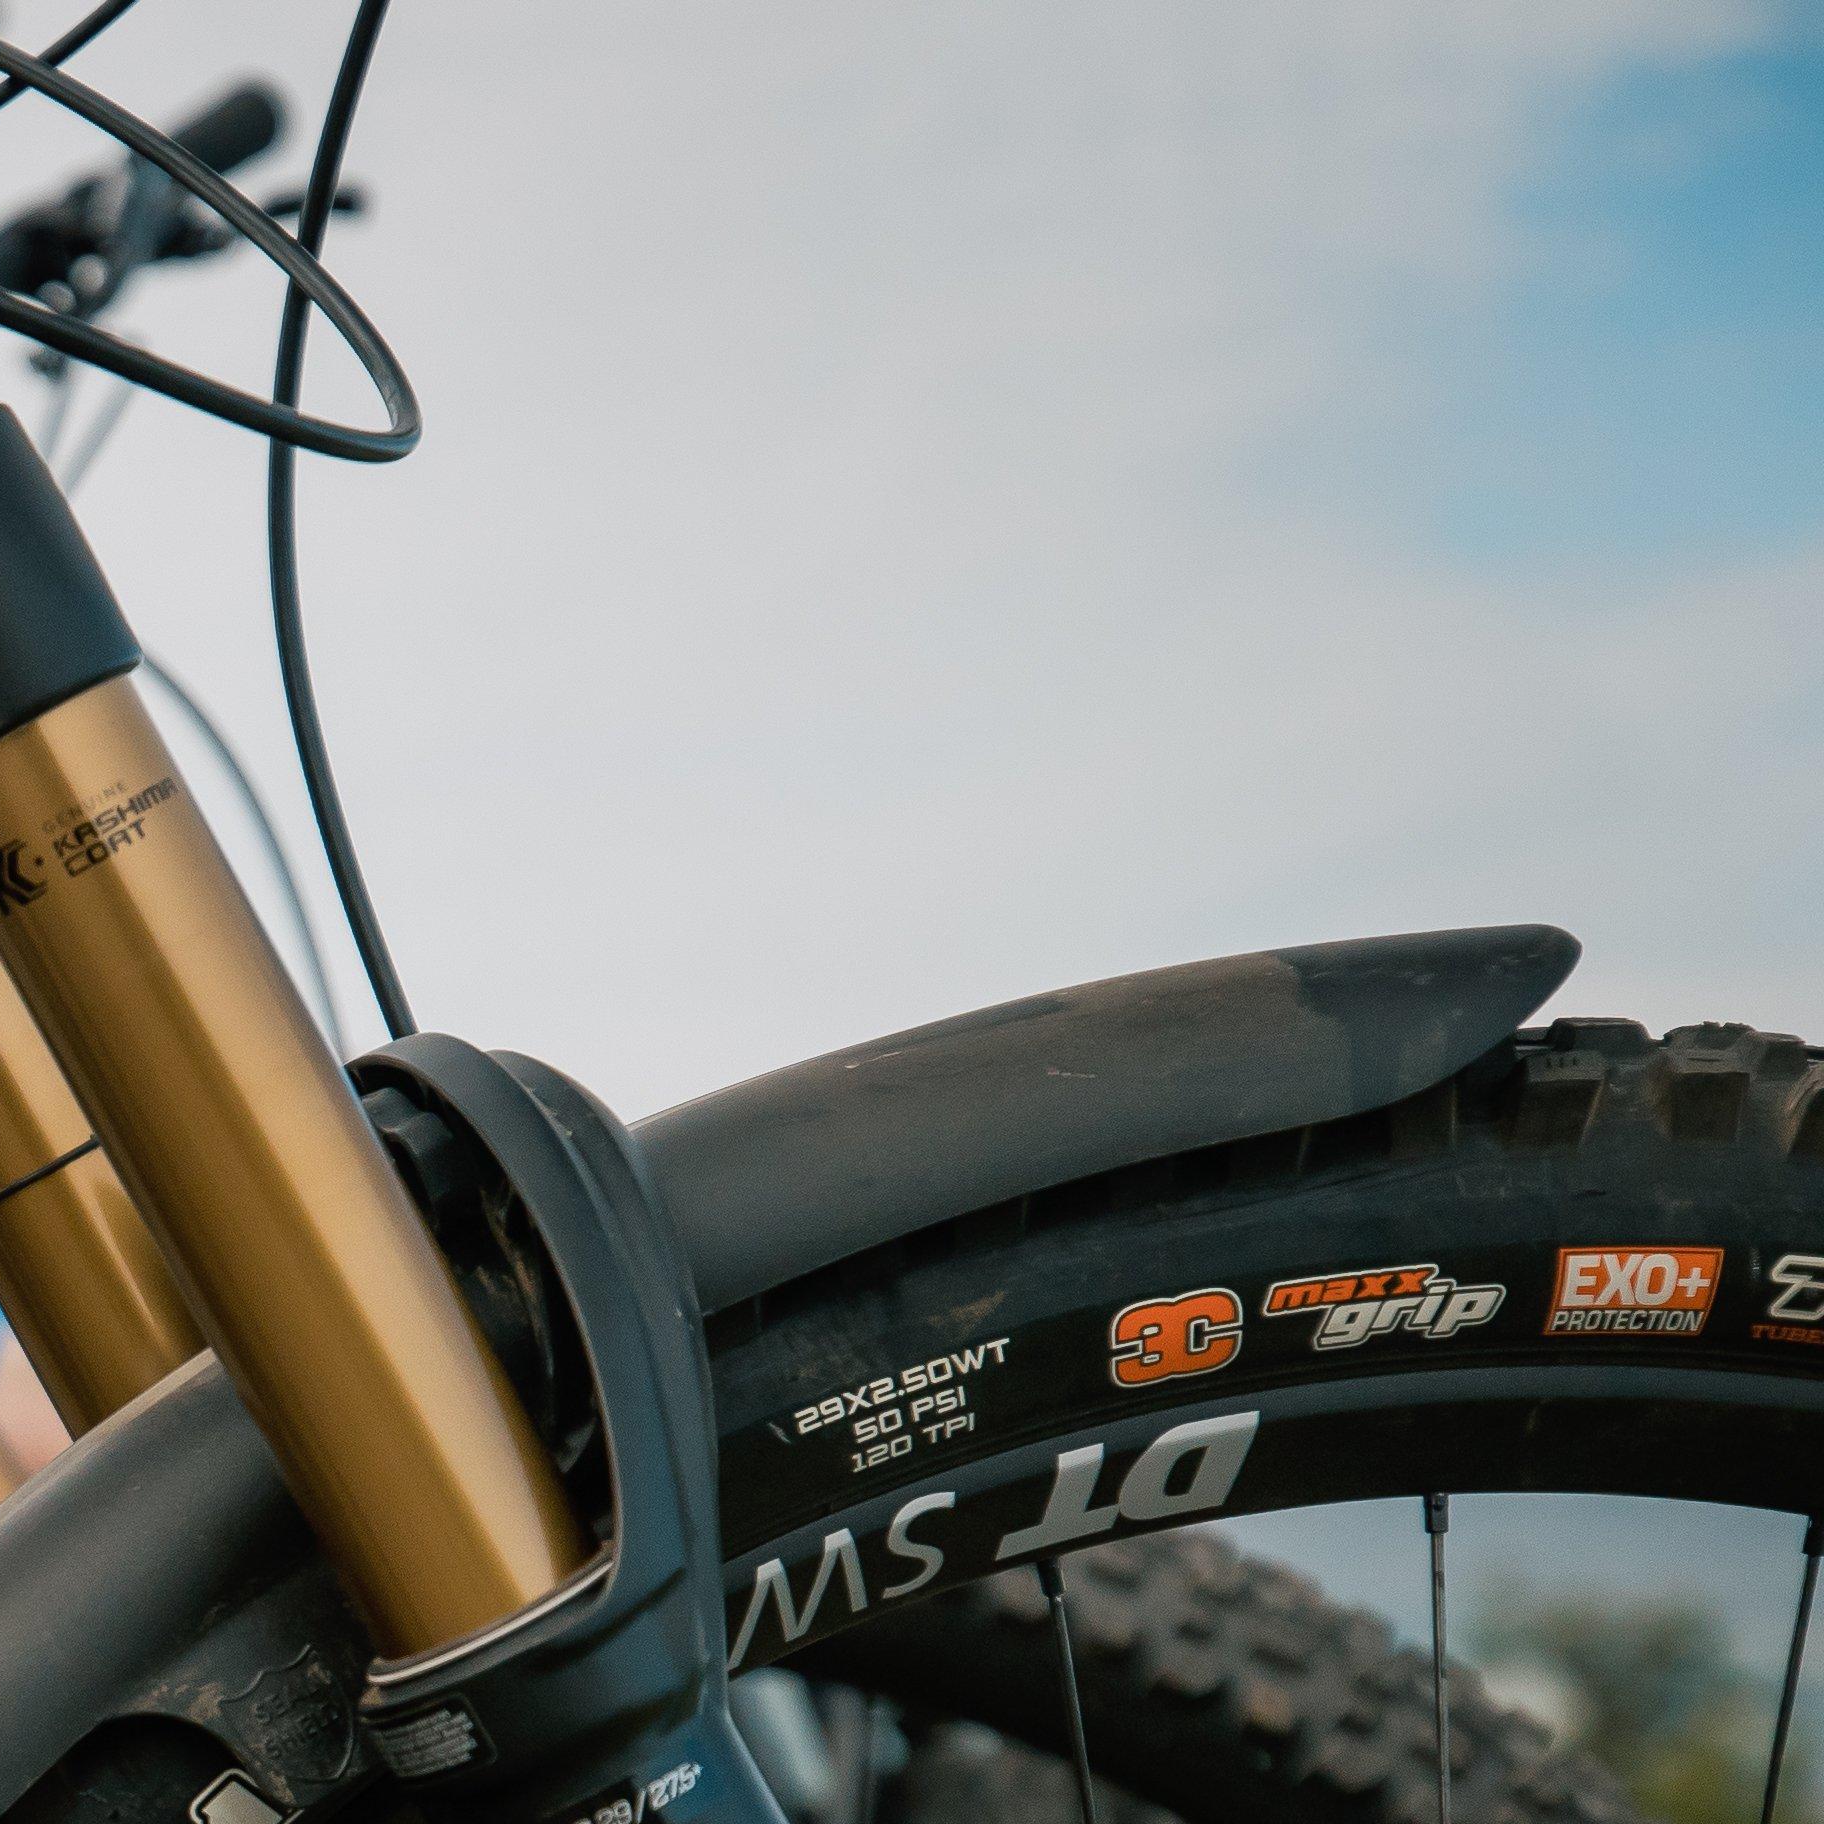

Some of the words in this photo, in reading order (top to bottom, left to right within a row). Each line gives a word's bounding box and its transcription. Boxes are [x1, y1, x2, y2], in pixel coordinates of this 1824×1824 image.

[54, 777, 179, 859] KASHIMA
[63, 817, 147, 878] COAT
[1561, 1253, 1711, 1307] EXO+
[1112, 1287, 1243, 1388] 3C
[1551, 1310, 1704, 1331] PROTECTION
[1752, 1325, 1824, 1345] TUBE
[794, 1337, 1010, 1435] 29X2.50WT
[853, 1408, 902, 1443] 50
[911, 1385, 966, 1422] PSI
[852, 1434, 912, 1472] 120
[922, 1412, 975, 1444] TPI
[994, 1410, 1260, 1561] DT
